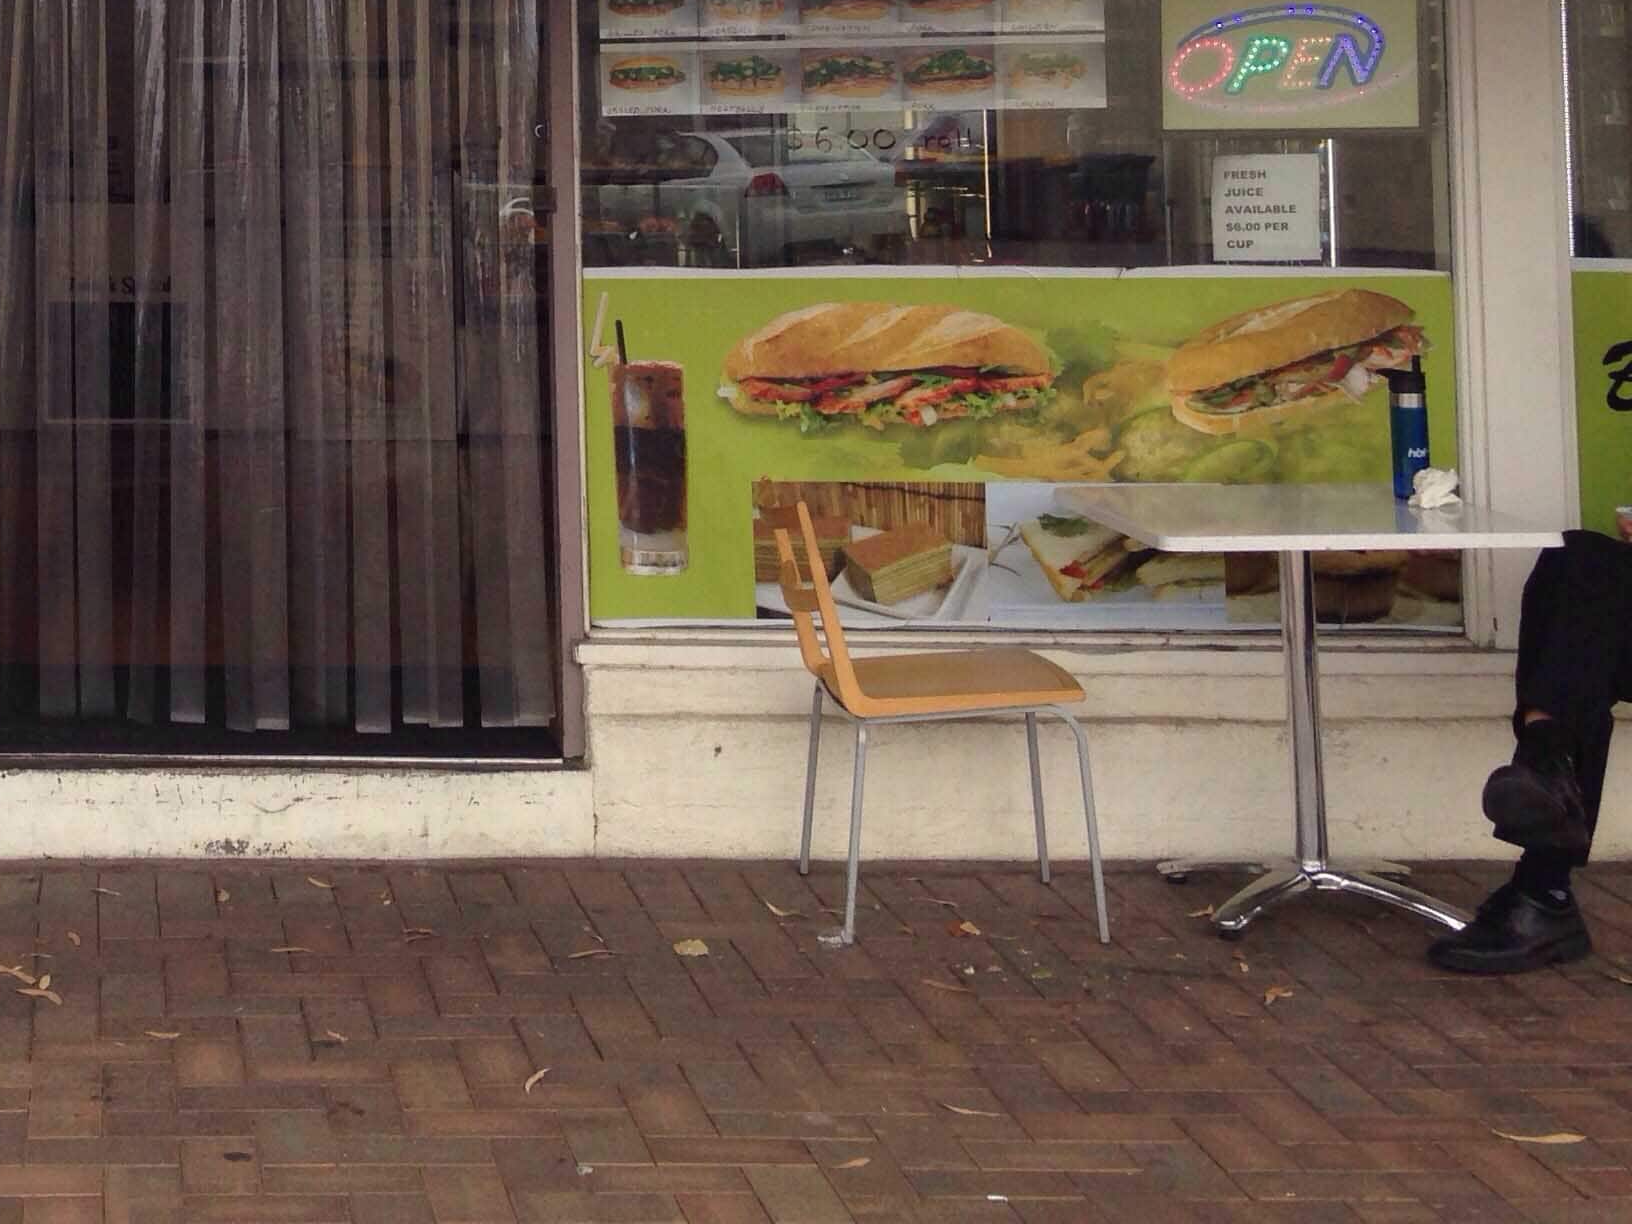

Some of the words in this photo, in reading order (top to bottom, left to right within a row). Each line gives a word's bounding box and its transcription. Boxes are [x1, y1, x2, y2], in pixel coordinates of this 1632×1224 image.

[1170, 32, 1385, 94] OPEN
[1224, 169, 1266, 180] FRESH
[1224, 187, 1264, 197] JUICE
[1225, 204, 1297, 214] AVAILABLE
[1265, 222, 1289, 231] PER
[1226, 239, 1255, 249] CUP
